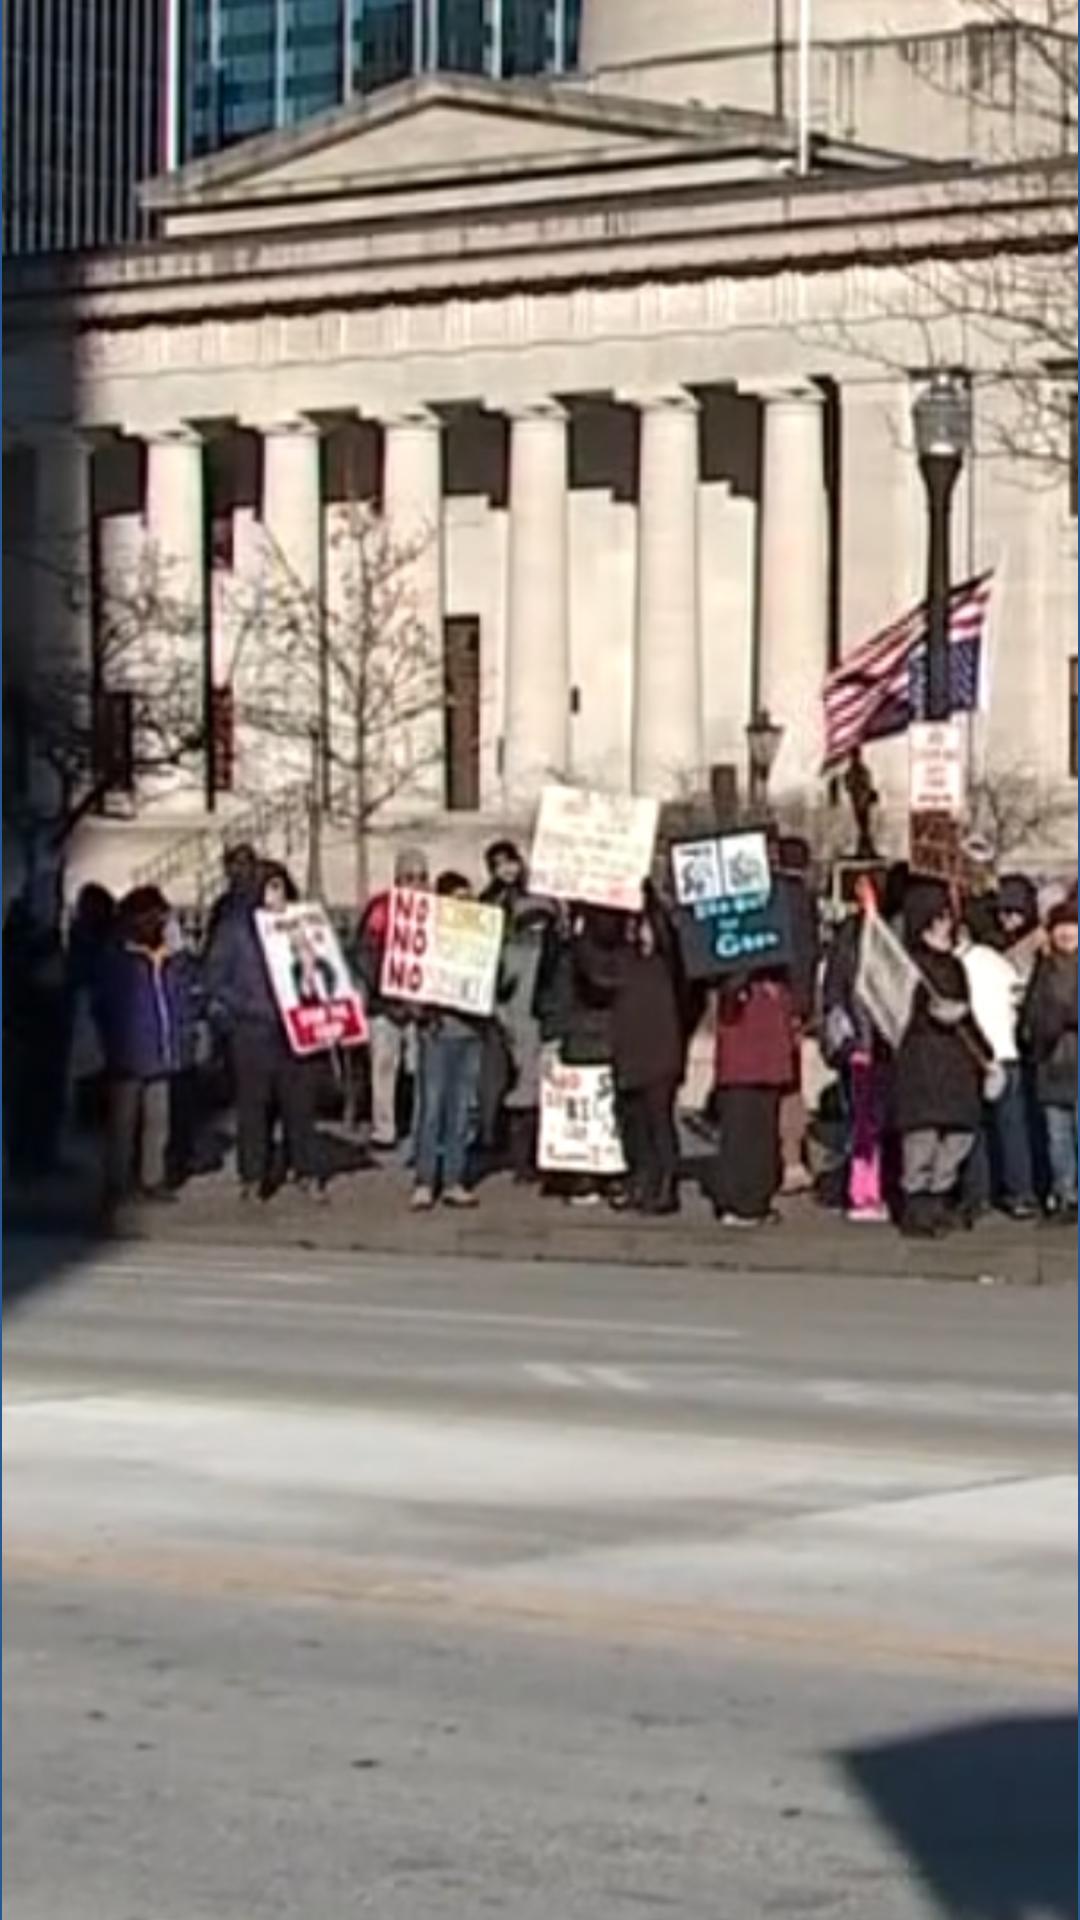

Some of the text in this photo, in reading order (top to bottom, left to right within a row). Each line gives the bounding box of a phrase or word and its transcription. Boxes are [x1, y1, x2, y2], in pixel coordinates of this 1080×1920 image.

[395, 891, 428, 923] NO
[392, 924, 426, 957] NO
[388, 957, 423, 993] NO
